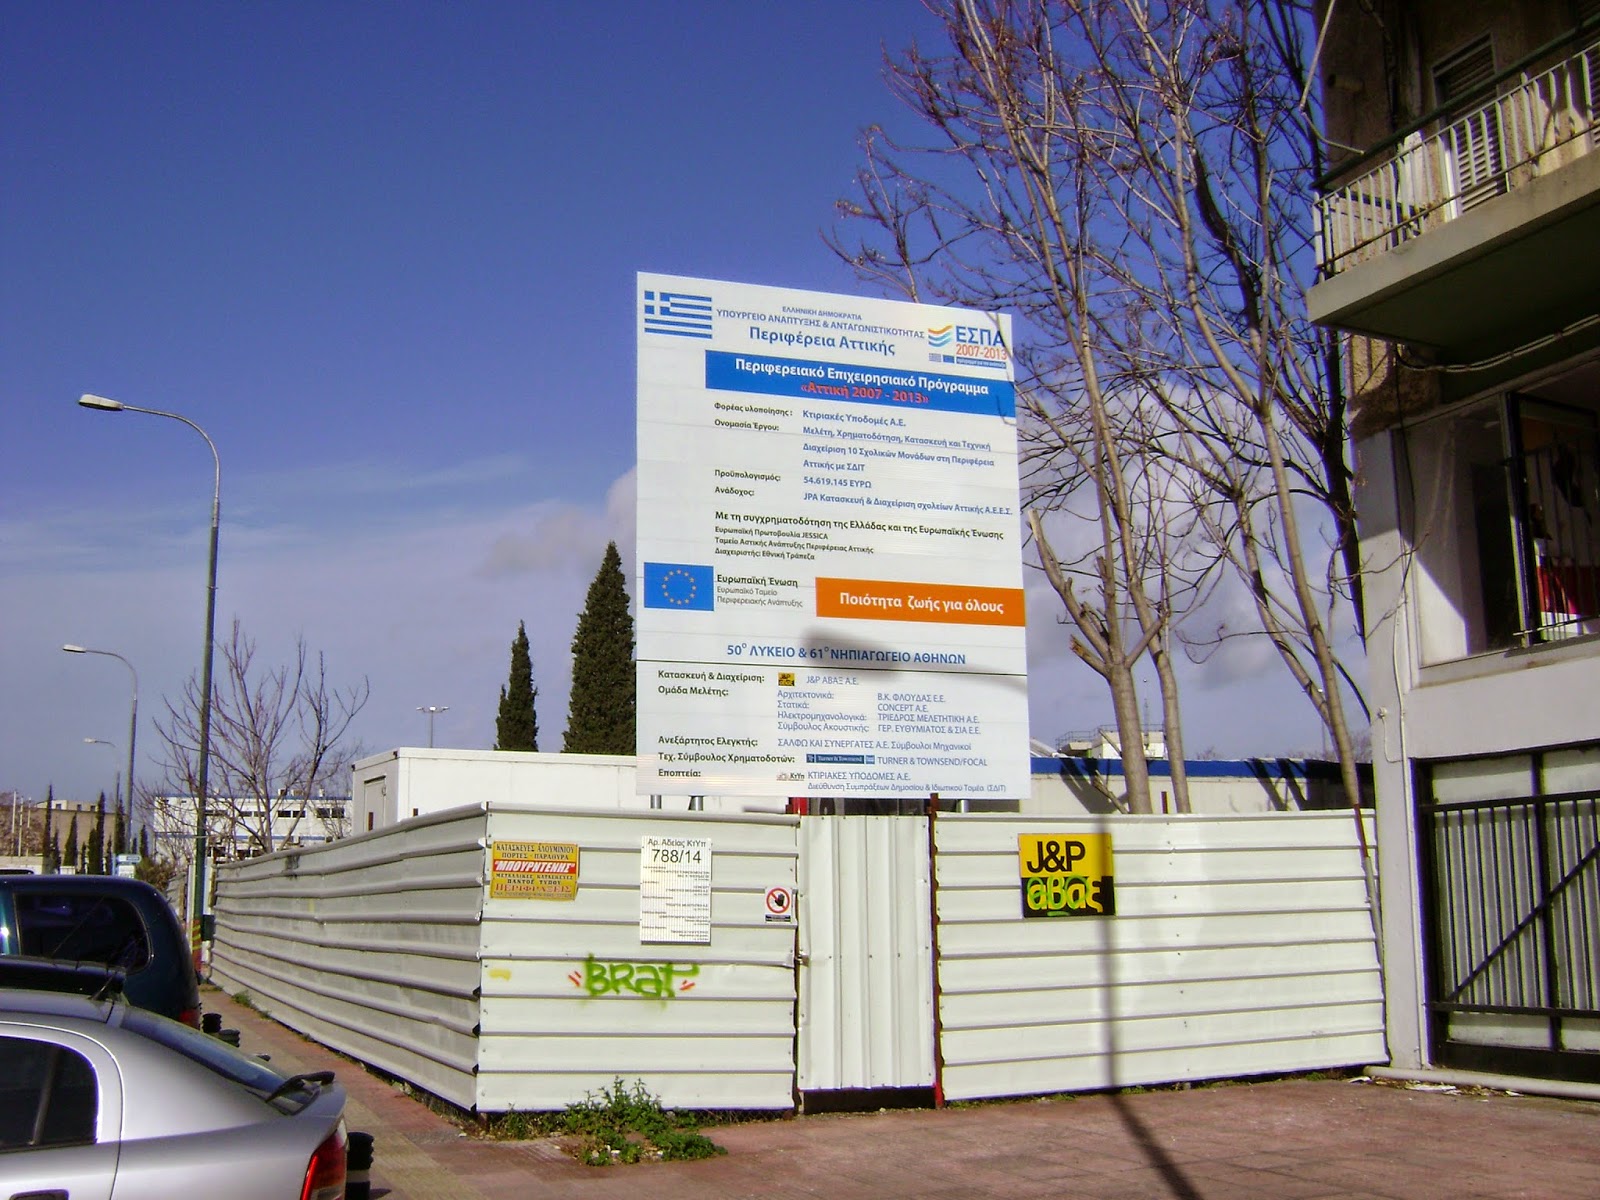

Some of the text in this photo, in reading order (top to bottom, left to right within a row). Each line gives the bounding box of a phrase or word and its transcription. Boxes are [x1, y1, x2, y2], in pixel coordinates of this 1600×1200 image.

[782, 306, 862, 321] ΕΛΛΗΝΙΚΗ ΔΗΜΟΚΡΑΤΙΑ
[716, 309, 767, 321] ΥΠΟΥΡΓΕΙΟ
[768, 315, 821, 327] ΑΝΑΠΤΥΞΗΣ
[830, 322, 925, 339] ΑΝΤΑΓΩΝΙΣΤΙΚΟΤΗΤΑΣ
[749, 326, 896, 356] Περιφέρεια Αττικής
[955, 325, 1005, 347] ΕΣΠΑ
[955, 343, 1008, 361] 2007-2013
[735, 358, 989, 396] Περιφερειακό Επιχειρησιακό Πρόγραμμα
[801, 381, 929, 404] «Αττική 2007 2013»
[714, 402, 743, 413] Φορέας
[714, 419, 780, 432] Ονομασία Έργου:
[802, 410, 906, 427] Κτιριακές Υποδομές Α.Ε.
[802, 426, 835, 438] Μελέτη,
[837, 429, 903, 443] Χρηματοδότηση,
[904, 435, 947, 448] Κατασκευή
[962, 441, 991, 452] Τεχνική
[802, 443, 994, 468] Διαχείριση 10 Σχολικών Μονάδων στη Περιφέρεια
[802, 459, 865, 472] Αττικής με ΣΔΙΤ
[714, 469, 781, 482] Προϋπολογισμός:
[803, 476, 872, 489] 54.619.145 ΕΥΡΩ
[714, 486, 755, 497] Ανάδοχος:
[819, 493, 865, 506] Κατασκευή
[866, 497, 873, 505] &
[873, 498, 916, 510] Διαχείριση
[917, 501, 953, 512] σχολείων
[953, 504, 984, 515] Αττικής
[715, 511, 729, 520] Με
[730, 514, 741, 523] τη
[743, 514, 832, 528] συγχρηματοδότηση
[833, 520, 848, 530] της
[849, 520, 887, 532] Ελλάδας
[902, 526, 918, 534] της
[919, 525, 970, 539] Ευρωπαϊκής
[971, 529, 1004, 540] Ένωσης
[715, 526, 829, 540] Ευρωπαϊκή Πρωτοβουλία JESSICA
[715, 537, 874, 555] Ταμείο Αστικής Ανάπτυξης Περιφέρειας Αττικής
[714, 547, 815, 561] Διαχειριστής: Εθνική Τράπεζα
[717, 574, 798, 588] Ευρωπαϊκή Ένωση
[717, 586, 778, 597] Ευρωπαϊκό Ταμείο
[717, 595, 803, 608] Περιφερειακής Ανάπτυξης
[839, 592, 1004, 615] Ποιότητα ζωής για όλους
[749, 645, 795, 658] ΛΥΚΕΙΟ
[798, 647, 807, 658] &
[830, 649, 911, 663] ΝΗΠΙΑΓΩΓΕΙΟ
[913, 652, 966, 665] ΑΘΗΝΩΝ
[658, 670, 706, 682] Κατασκευή
[708, 672, 715, 680] &
[716, 672, 765, 684] Διαχείριση:
[821, 676, 843, 686] ΑΒΑΞ
[657, 685, 729, 698] Ομάδα Μελέτης:
[777, 690, 835, 701] Αρχιτεκτονικά:
[892, 693, 931, 703] ΦΛΟΥΔΑΣ
[777, 700, 810, 710] Στατικά:
[877, 703, 913, 713] CONCEPT
[777, 711, 867, 723] Ηλεκτρομηχανολογικά:
[877, 713, 915, 723] ΤΡΙΕΔΡΟΣ
[916, 714, 965, 724] ΜΕΛΕΤΗΤΙΚΗ
[777, 721, 821, 733] Σύμβουλος
[895, 725, 947, 735] ΕΥΘΥΜΙΑΤΟΣ
[954, 726, 968, 735] ΣΙΑ
[657, 735, 758, 749] Ανεξάρτητος Ελεγκτής:
[777, 739, 808, 748] ΣΑΛΦΩ
[809, 739, 823, 748] ΚΑΙ
[824, 740, 875, 750] ΣΥΝΕΡΓΑΤΕΣ
[891, 741, 932, 752] Σύμβουλοι
[932, 742, 972, 753] Μηχανικοί
[658, 752, 676, 763] Τεχ.
[677, 753, 726, 765] Σύμβουλος
[727, 755, 796, 766] Χρηματοδοτών:
[877, 756, 908, 765] TURNER
[909, 757, 915, 765] &
[916, 757, 987, 767] TOWNSEND/FOCAL
[658, 769, 701, 780] Εποπτεία:
[807, 771, 847, 780] ΚΤΙΡΙΑΚΕΣ
[848, 772, 895, 781] ΥΠΟΔΟΜΕΣ
[807, 783, 845, 792] Διεύθυνση
[845, 783, 889, 792] Συμπράξεων
[890, 784, 924, 792] Δημοσίου
[931, 784, 963, 792] Ιδιωτικού
[651, 848, 702, 864] 788/14
[1026, 840, 1086, 873] J&P
